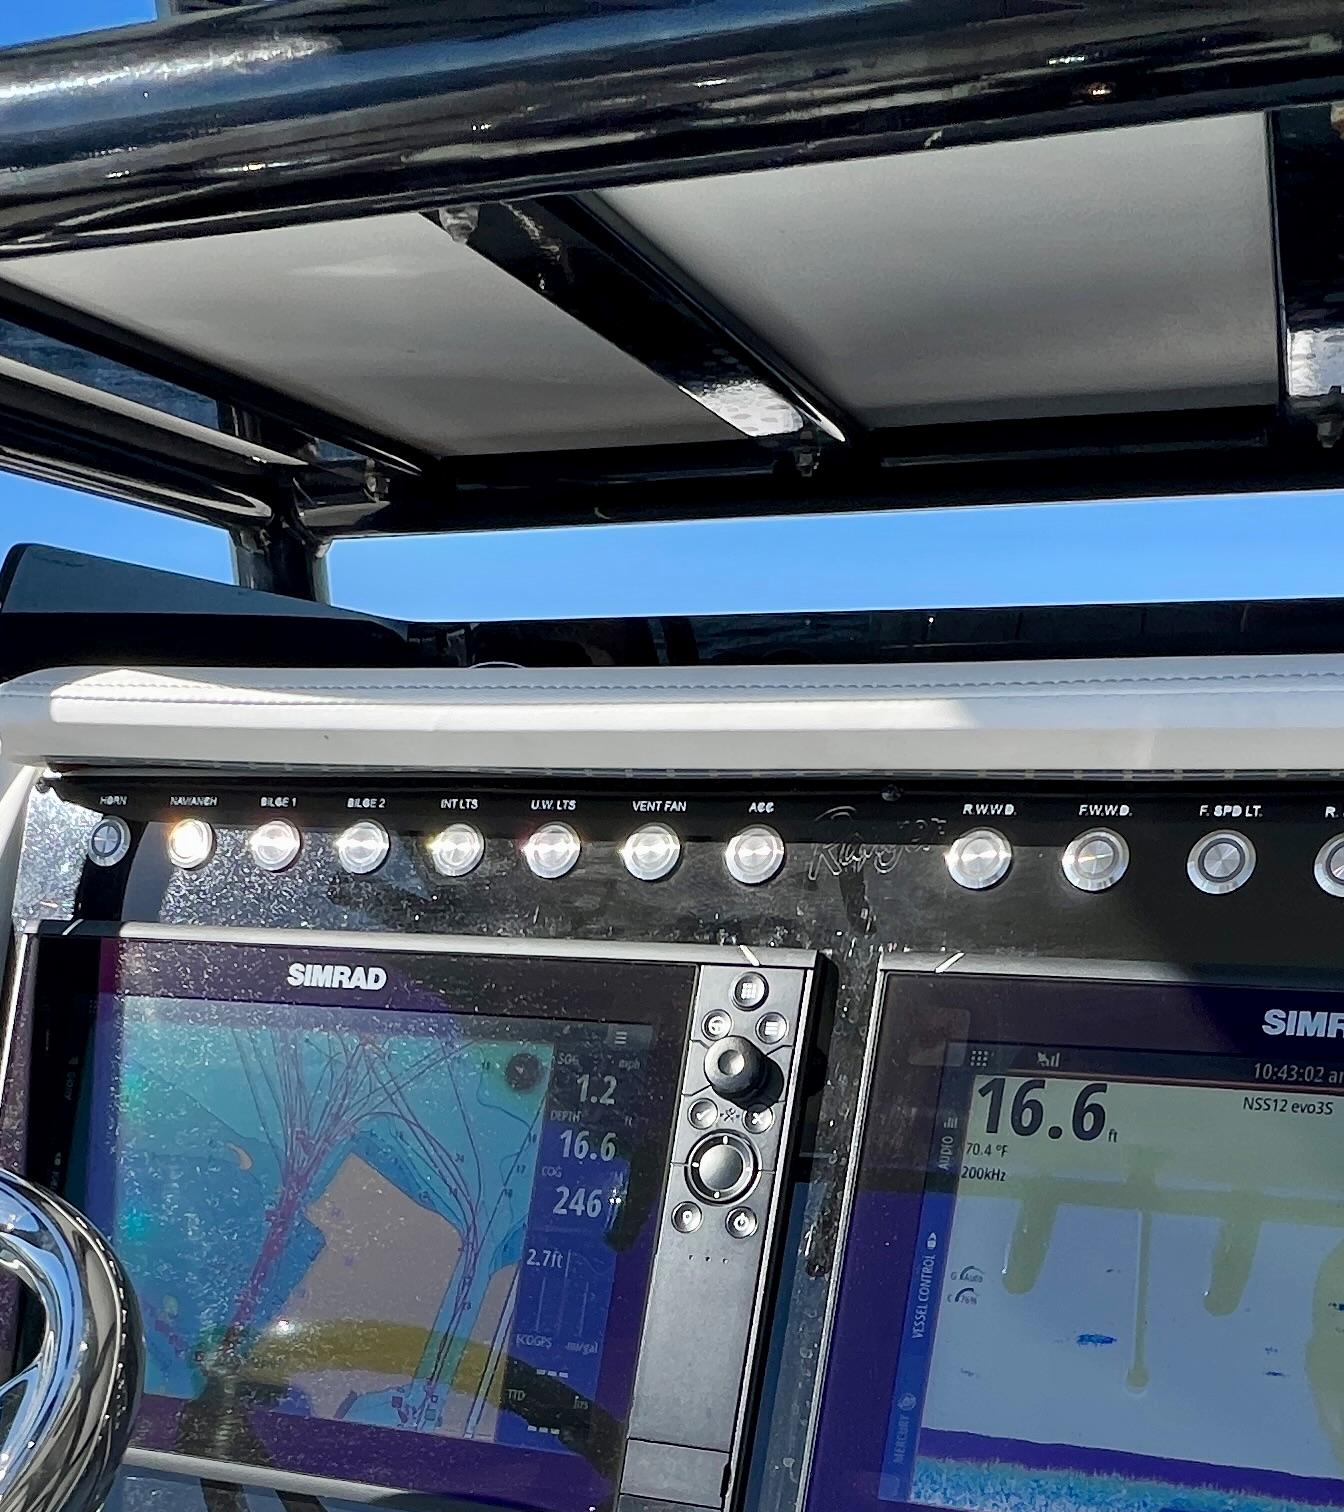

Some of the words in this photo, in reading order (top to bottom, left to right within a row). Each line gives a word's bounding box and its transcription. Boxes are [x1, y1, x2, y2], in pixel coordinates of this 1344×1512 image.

[260, 797, 289, 807] BILGE
[347, 798, 376, 808] BILGE
[378, 799, 386, 808] 2
[441, 799, 458, 809] INT
[459, 799, 478, 809] LTS
[556, 800, 576, 810] LTS
[632, 801, 662, 812] VENT
[664, 801, 687, 812] FAN
[748, 802, 774, 812] ACC
[1199, 805, 1210, 817] F.
[1213, 804, 1242, 817] SPD
[1325, 806, 1338, 818] R.
[287, 963, 387, 990] SIMRAD
[1254, 1063, 1324, 1082] 10:43:02
[577, 1074, 617, 1104] 1.2
[978, 1077, 1108, 1141] 16.6
[1108, 1128, 1118, 1143] ft
[1243, 1097, 1287, 1112] NSS12
[1291, 1101, 1333, 1115] evo3S
[551, 1110, 582, 1122] DEPTH
[560, 1130, 617, 1161] 16.6
[938, 1136, 954, 1170] AUDIO
[966, 1142, 992, 1156] 70.4
[541, 1166, 562, 1178] COG
[961, 1166, 1007, 1182] 200kHz
[553, 1186, 602, 1218] 246
[527, 1249, 563, 1268] 2.7ft
[918, 1254, 936, 1303] CONTROL
[912, 1304, 929, 1339] VESSEL
